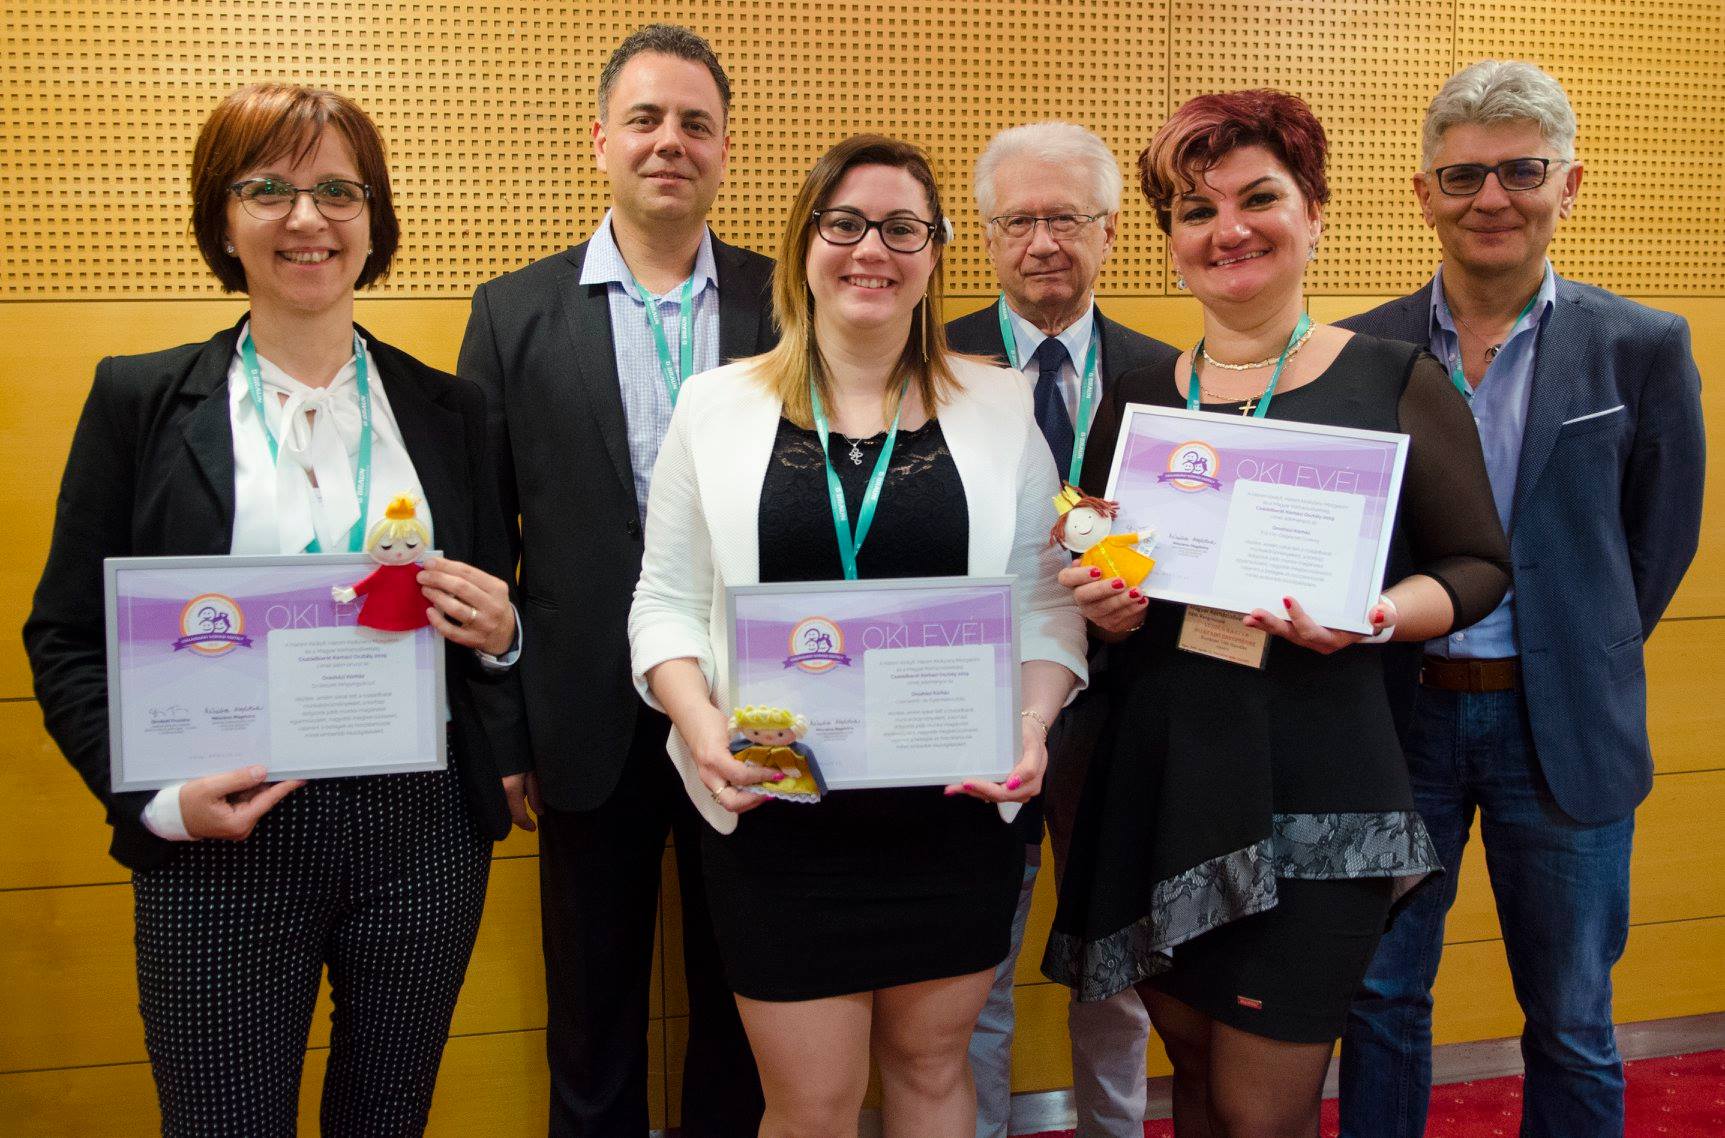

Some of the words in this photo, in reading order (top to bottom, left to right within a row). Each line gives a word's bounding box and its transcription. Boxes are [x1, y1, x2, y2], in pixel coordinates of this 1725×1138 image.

[253, 376, 262, 403] BRAUN
[666, 367, 678, 390] BRAUN
[1086, 378, 1094, 399] BRAUN
[357, 468, 365, 496] BRAUN
[266, 603, 360, 630] OKLE
